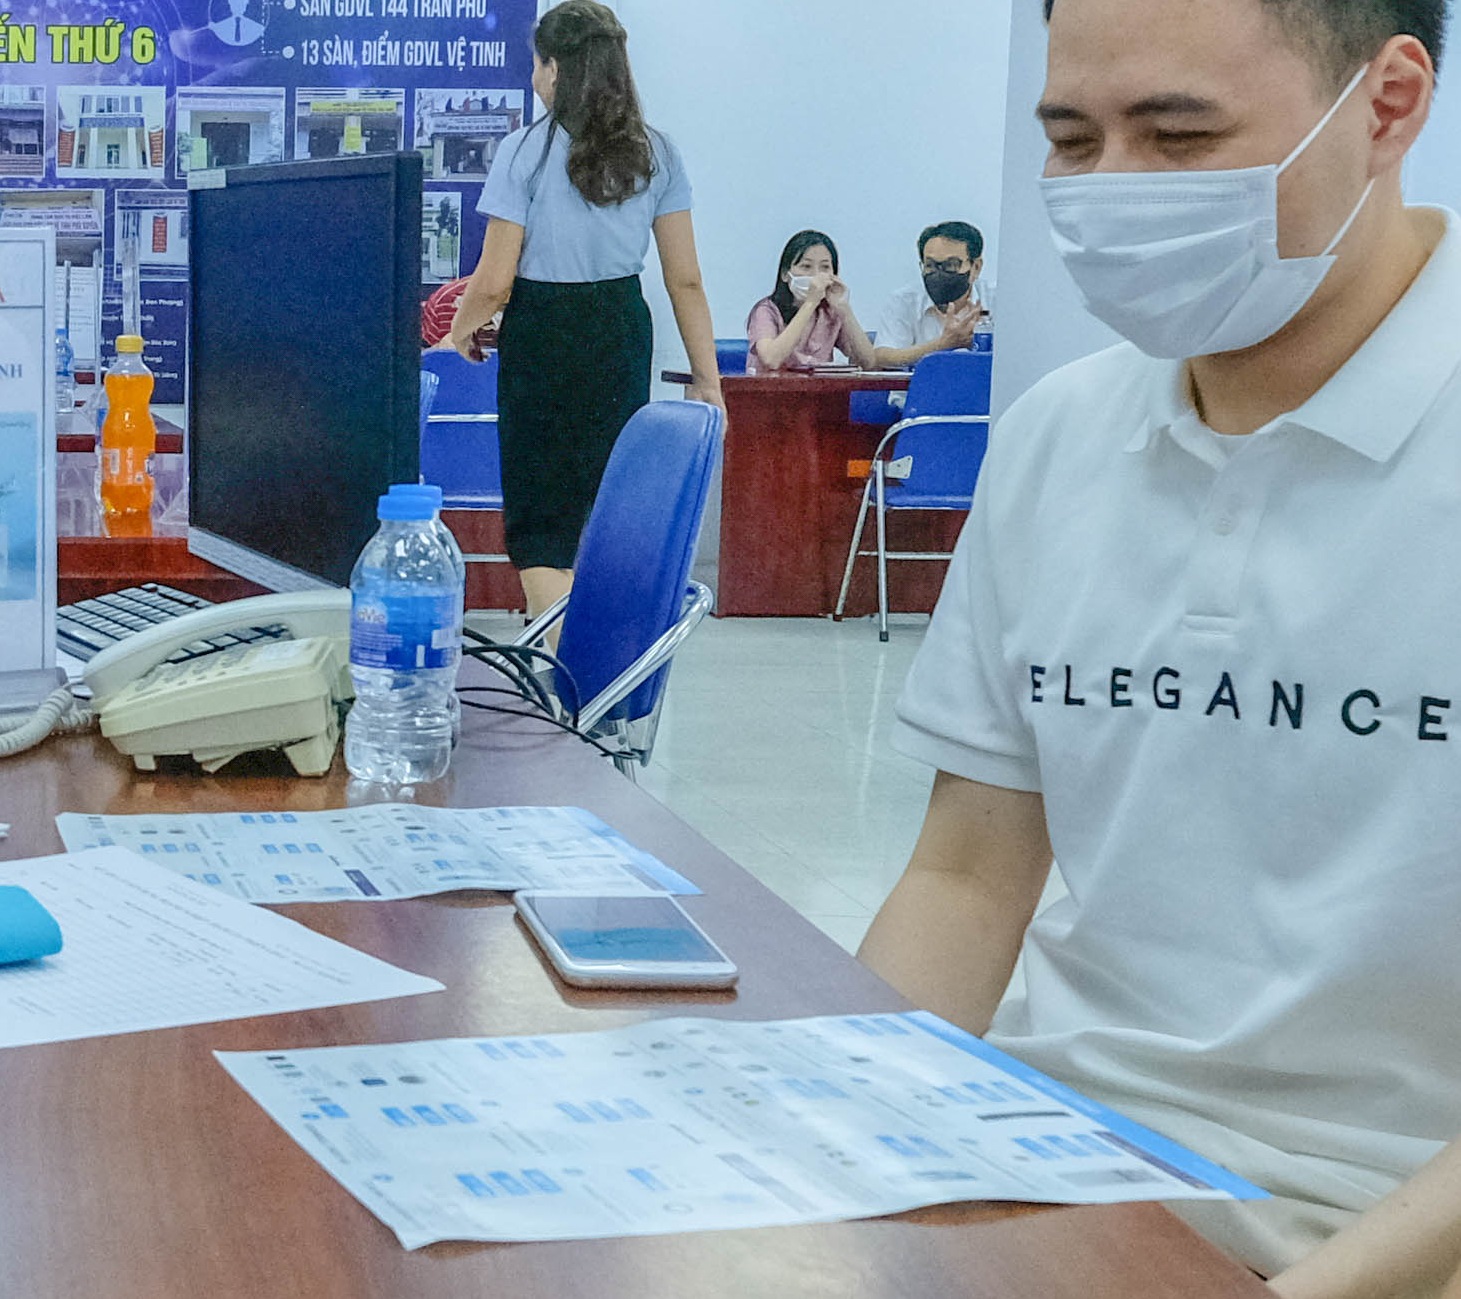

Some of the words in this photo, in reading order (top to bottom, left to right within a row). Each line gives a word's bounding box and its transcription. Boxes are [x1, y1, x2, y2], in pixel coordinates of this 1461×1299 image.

[47, 17, 127, 64] THỨ
[132, 26, 157, 65] 6
[301, 39, 320, 66] 13
[322, 34, 358, 68] SÀN,
[362, 30, 401, 67] ĐIỂM
[404, 41, 443, 67] GDVL
[446, 35, 466, 72] VỆ
[470, 41, 506, 68] TINH
[1030, 664, 1451, 742] ELEGANCE
